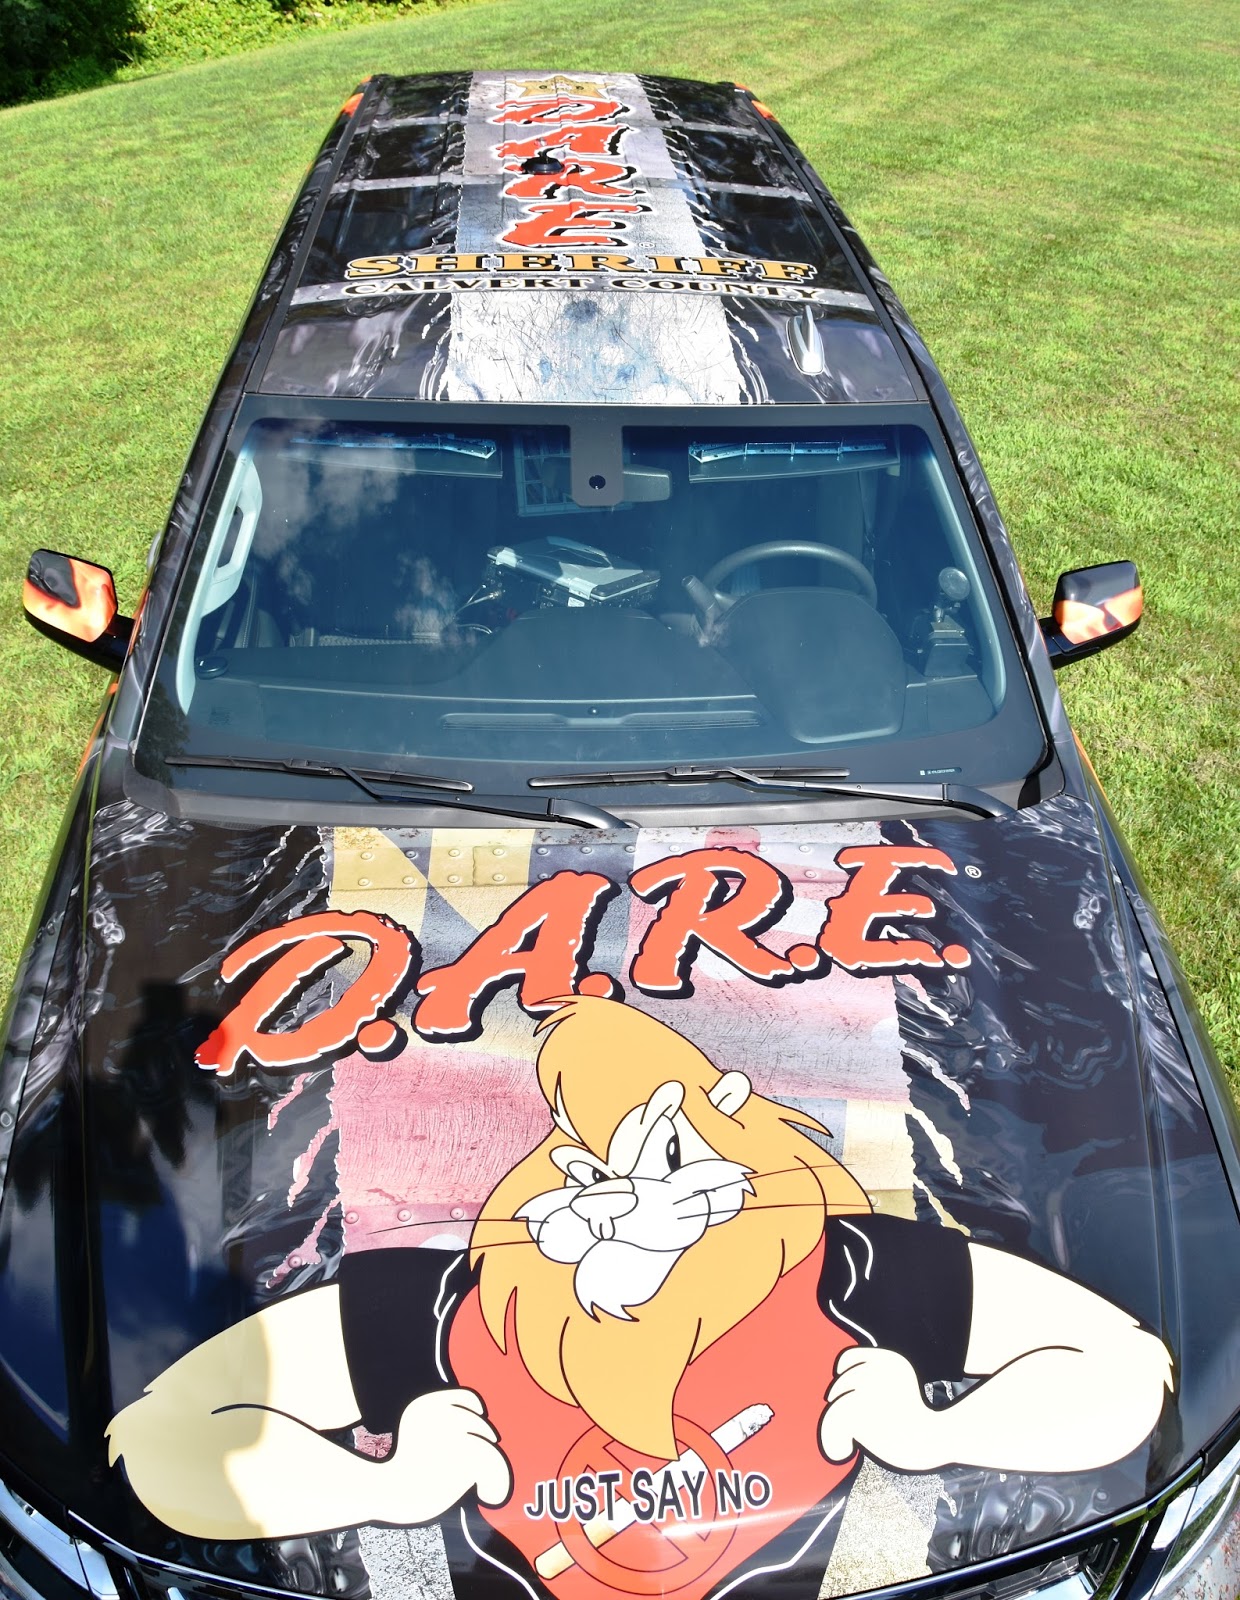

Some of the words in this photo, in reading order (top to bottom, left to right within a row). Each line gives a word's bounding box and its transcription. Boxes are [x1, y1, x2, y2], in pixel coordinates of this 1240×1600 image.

[346, 253, 817, 282] SHERIFF
[344, 277, 593, 295] CALVERT
[611, 279, 825, 300] COUNTY
[525, 1471, 621, 1522] JUST
[632, 1469, 706, 1521] SAY
[717, 1470, 771, 1513] NO
